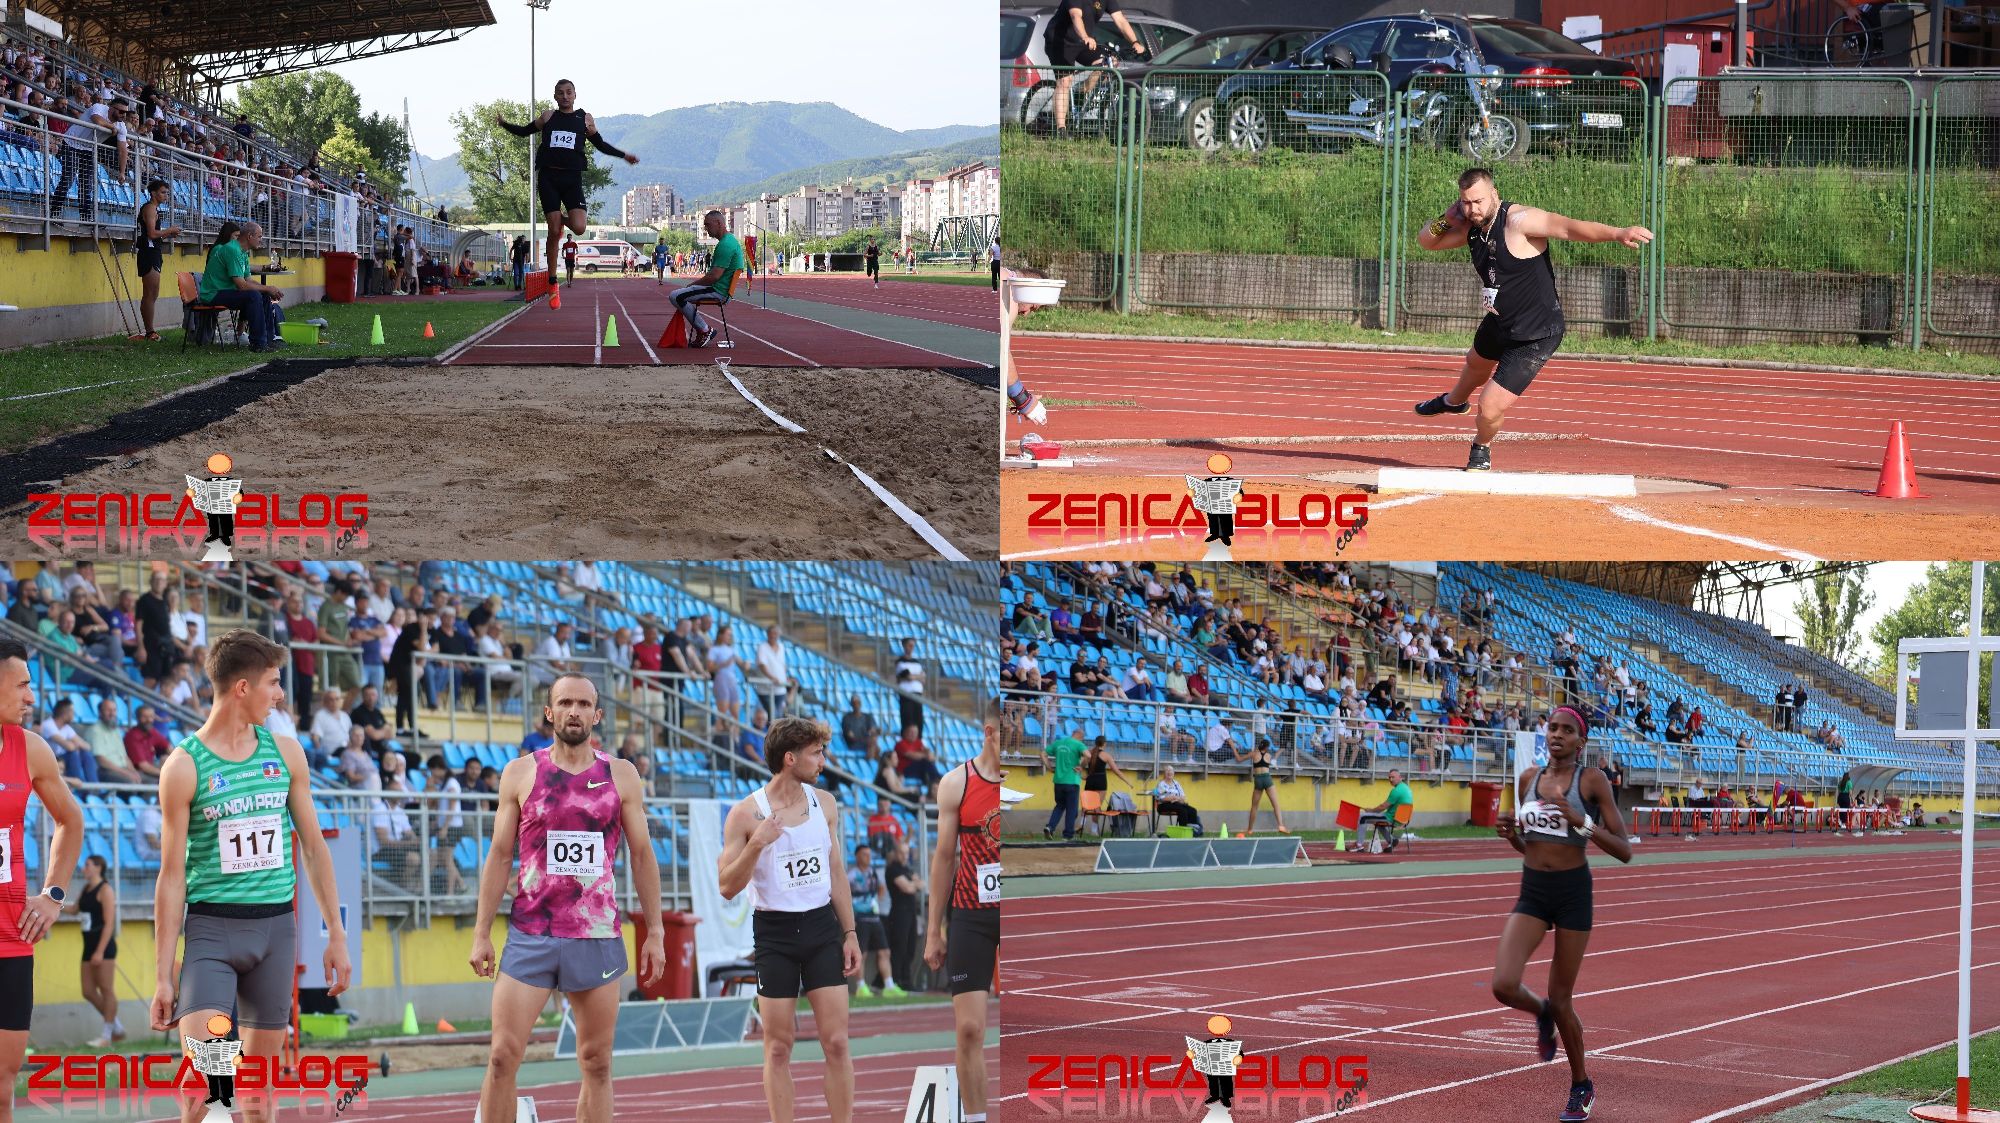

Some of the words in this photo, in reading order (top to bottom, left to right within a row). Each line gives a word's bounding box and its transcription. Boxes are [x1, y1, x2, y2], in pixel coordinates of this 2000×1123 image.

[554, 134, 573, 144] 142
[203, 803, 222, 822] AK
[224, 795, 254, 816] NOVI
[230, 829, 275, 857] 117
[554, 842, 594, 863] 031
[784, 856, 821, 879] 123
